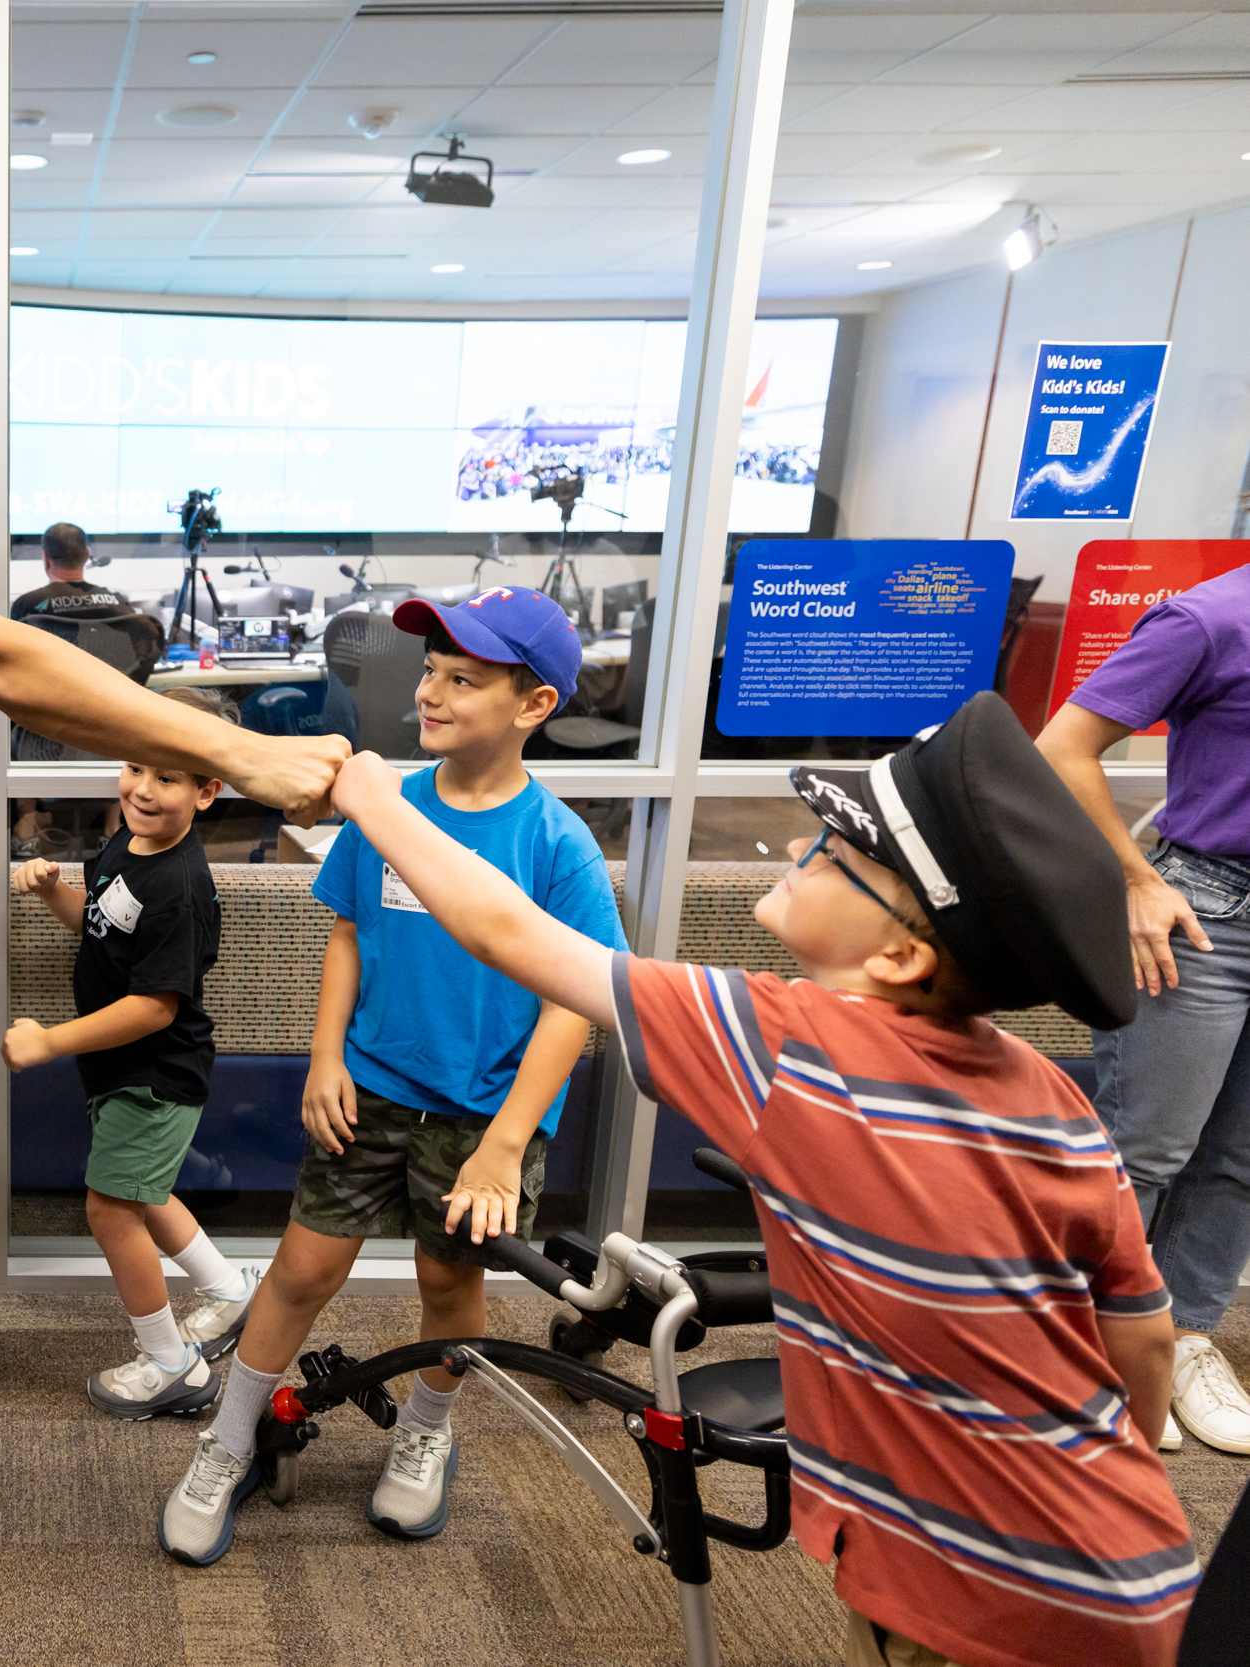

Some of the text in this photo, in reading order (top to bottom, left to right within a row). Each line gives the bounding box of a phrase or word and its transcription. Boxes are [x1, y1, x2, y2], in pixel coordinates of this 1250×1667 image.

[1047, 355, 1102, 369] We love
[1041, 380, 1125, 395] Kidd's Kids!
[1040, 405, 1105, 414] Scan to donate!
[193, 431, 236, 457] keep
[305, 437, 330, 457] up
[897, 575, 925, 583] Dallas
[931, 571, 958, 582] plane
[752, 579, 847, 596] Southwest
[893, 584, 916, 592] seats
[916, 581, 959, 594] airline
[907, 593, 970, 602] snack takeoff
[1088, 589, 1140, 606] Share
[1144, 589, 1165, 606] of
[750, 601, 856, 617] Word Cloud
[877, 631, 910, 639] frequently
[792, 666, 827, 674] throughout
[829, 691, 855, 699] in-depth
[401, 901, 417, 909] Escort
[124, 913, 132, 922] V
